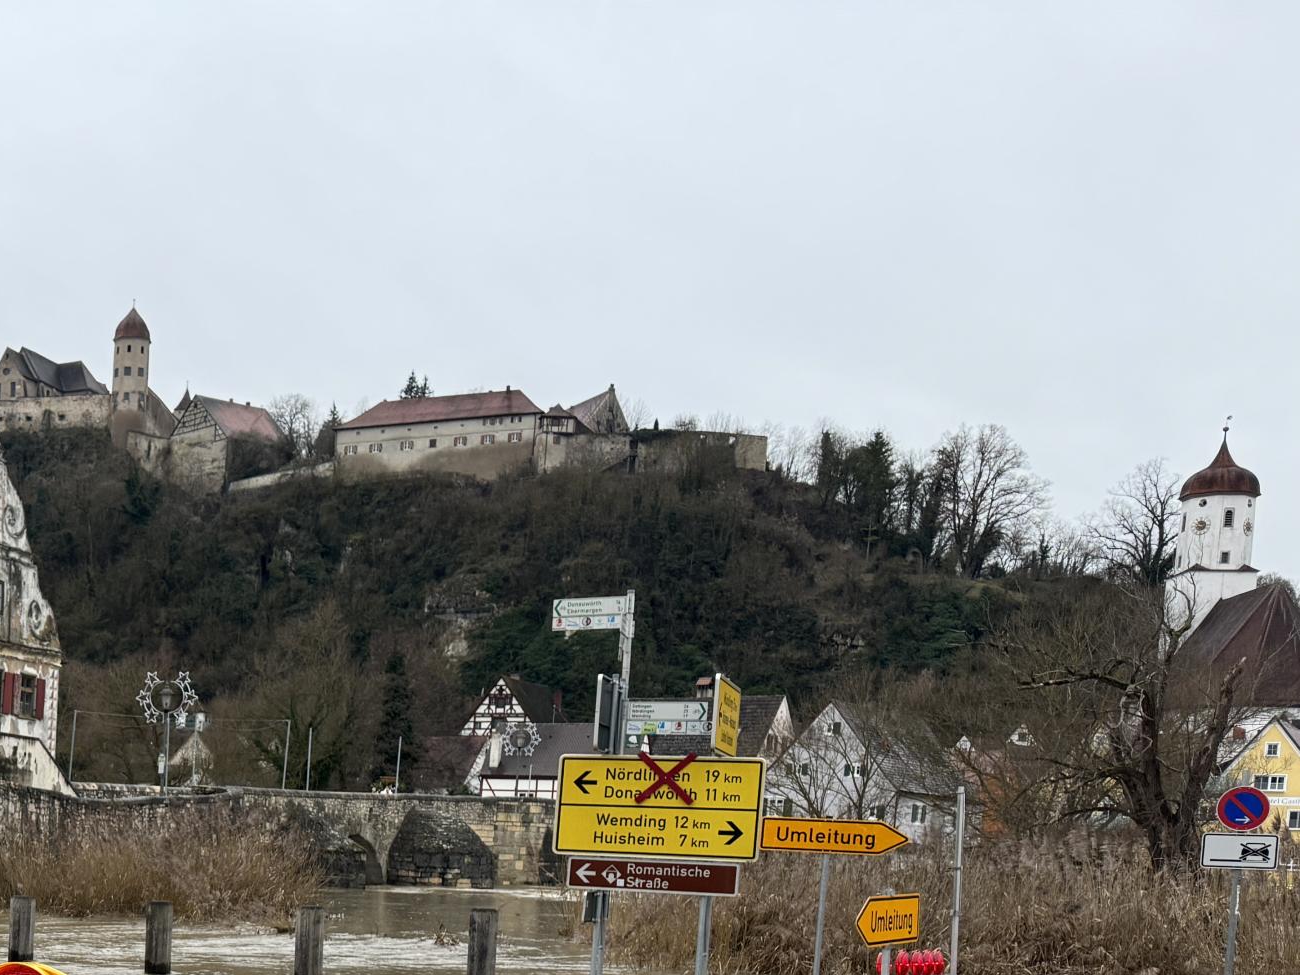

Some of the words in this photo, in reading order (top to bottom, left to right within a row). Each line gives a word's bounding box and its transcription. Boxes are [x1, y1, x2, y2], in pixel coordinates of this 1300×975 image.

[705, 769, 720, 783] 19
[724, 773, 742, 784] km
[705, 788, 717, 801] 11
[722, 791, 741, 802] km
[596, 812, 667, 831] Wemding
[674, 815, 689, 829] 12
[692, 819, 711, 830] km
[593, 831, 665, 846] Huisheim
[679, 834, 688, 847] 7
[691, 837, 709, 848] km
[776, 826, 876, 850] Umleitung
[627, 863, 711, 878] Romantische
[626, 876, 669, 889] Straße
[870, 909, 913, 934] Umleitung
